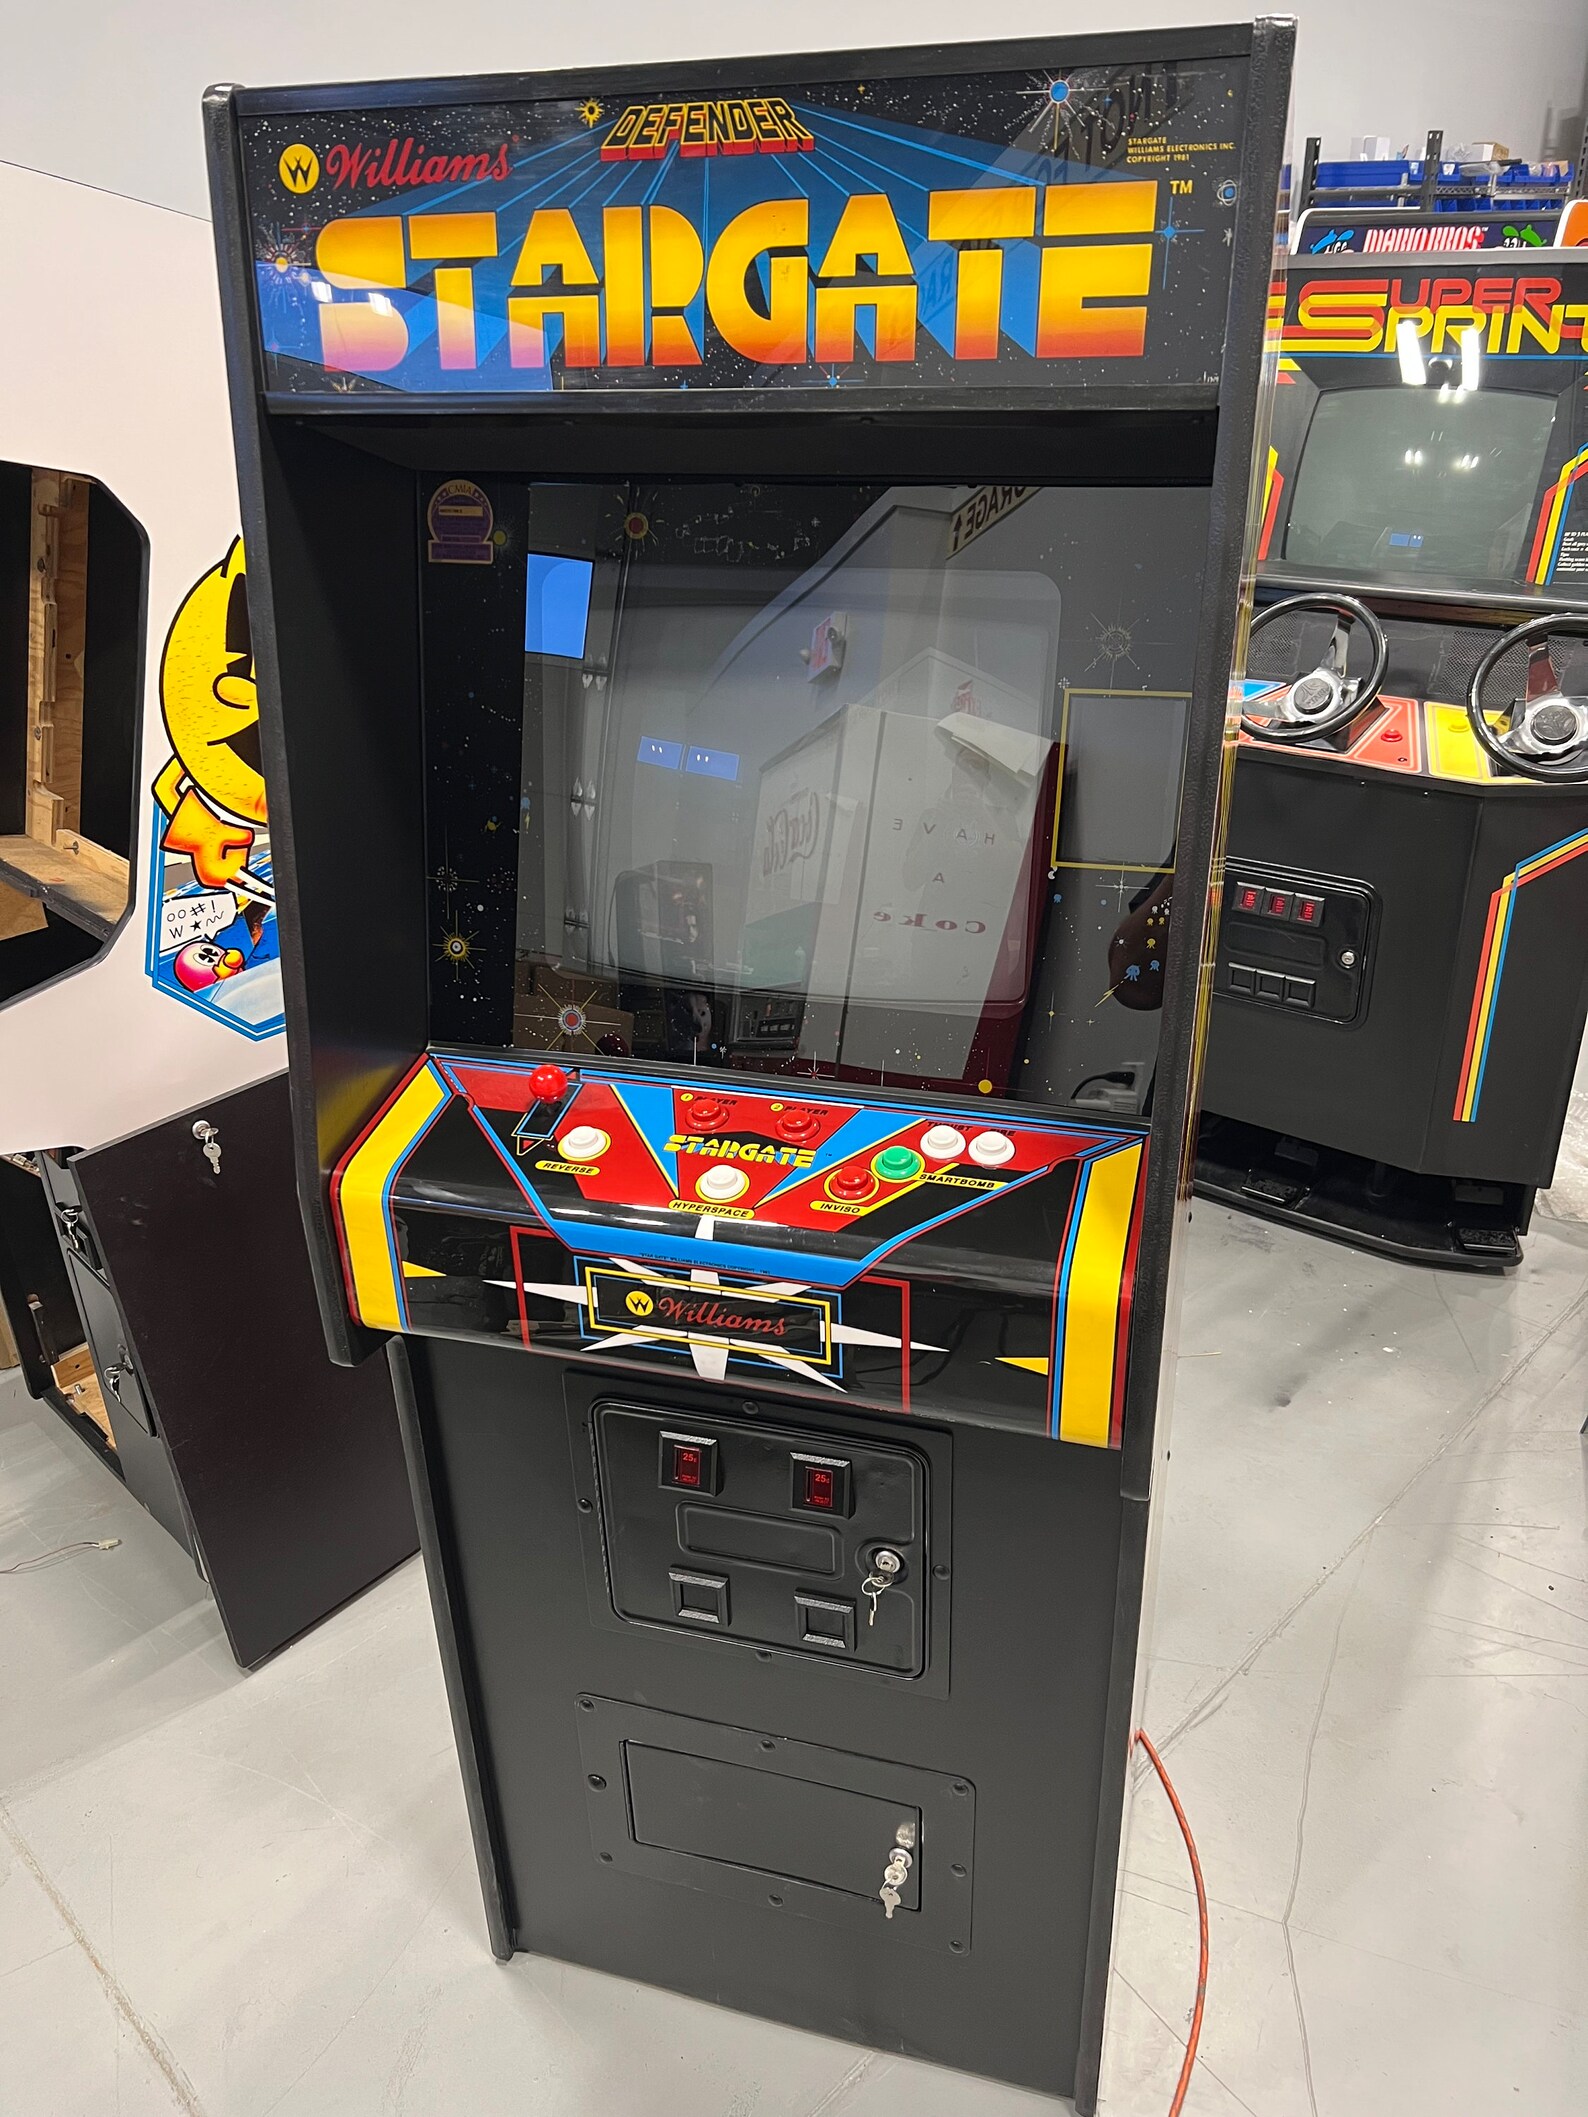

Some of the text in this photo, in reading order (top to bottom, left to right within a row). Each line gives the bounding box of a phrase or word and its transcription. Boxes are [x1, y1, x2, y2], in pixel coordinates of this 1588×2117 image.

[601, 97, 815, 161] DEFENDER
[1127, 136, 1167, 146] STARGATE
[1127, 145, 1165, 154] WILLIAMS
[1166, 143, 1218, 153] ELECTRONICS
[326, 137, 514, 190] Williams
[1126, 153, 1190, 163] COPYRIGHT 1981
[315, 179, 1159, 372] STARGATE
[1169, 179, 1194, 195] TM
[1292, 277, 1570, 338] SUPER
[662, 1134, 818, 1168] STARGATE
[543, 1162, 595, 1175] REVERSE
[919, 1173, 996, 1189] SMARTBOMB
[672, 1201, 750, 1218] HYPERSPACE
[819, 1202, 861, 1215] INVISO
[658, 1296, 788, 1337] Williams
